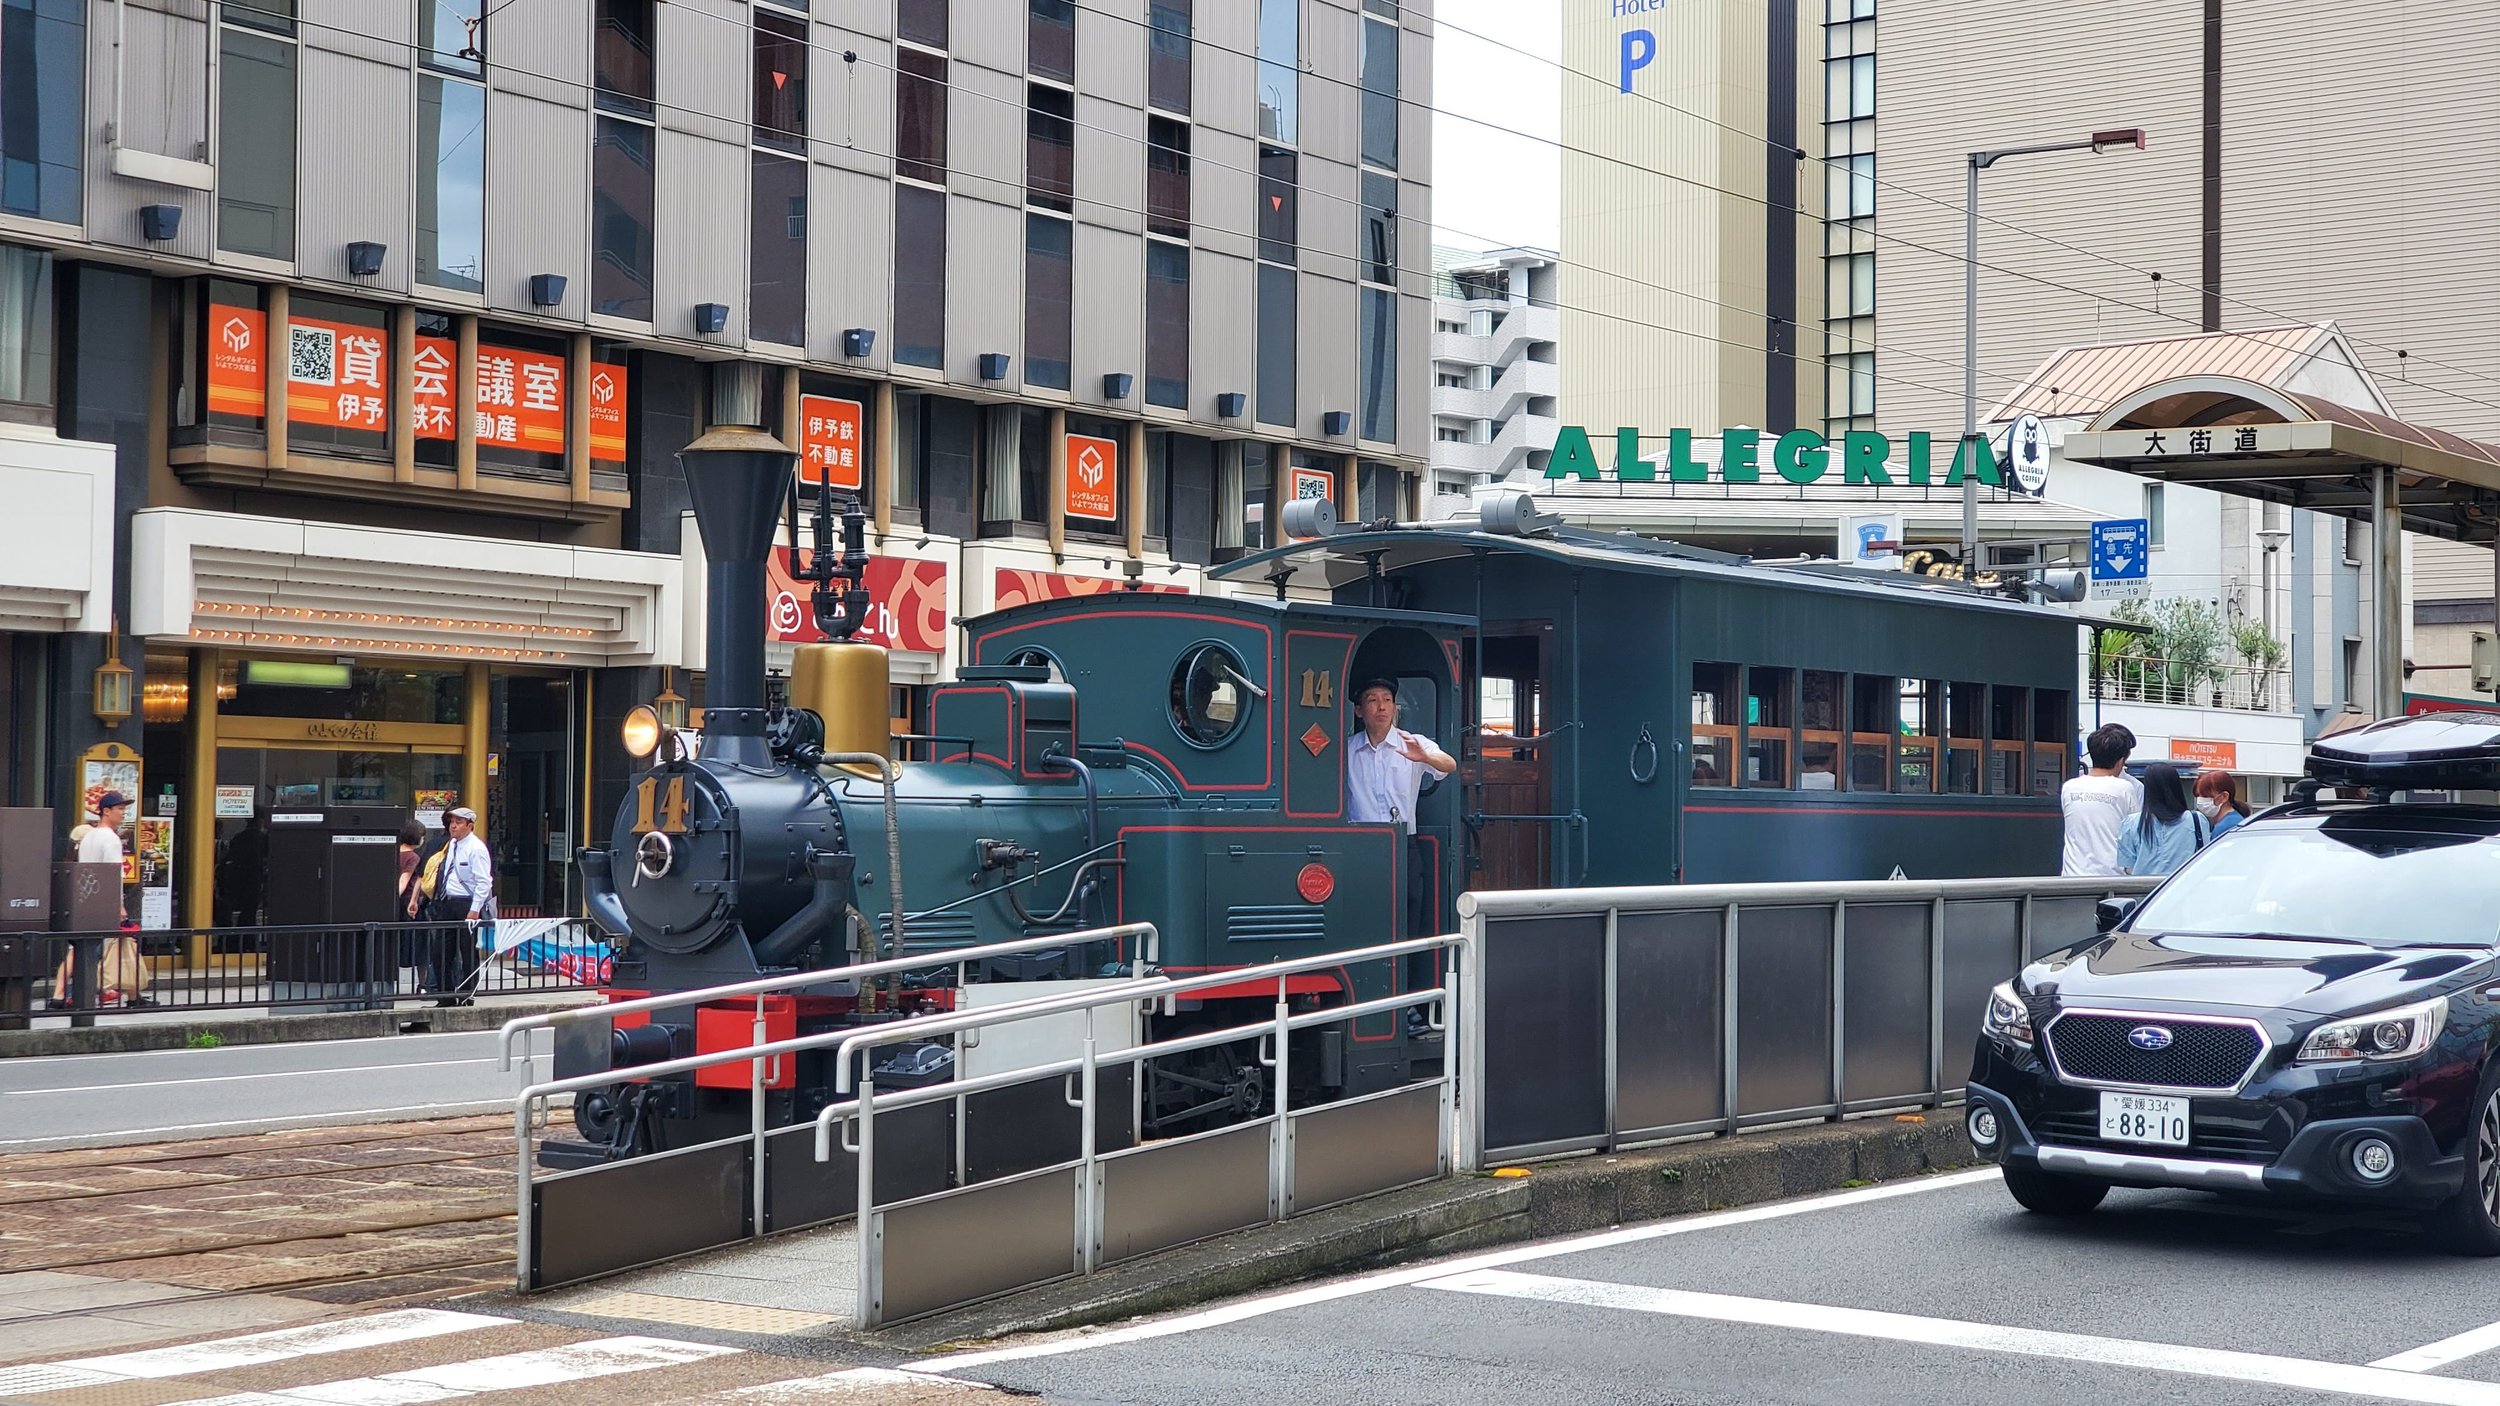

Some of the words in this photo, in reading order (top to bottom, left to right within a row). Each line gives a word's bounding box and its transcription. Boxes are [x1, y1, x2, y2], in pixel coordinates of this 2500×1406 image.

[1621, 29, 1656, 94] P
[808, 416, 854, 441] 伊予鉄
[2144, 427, 2258, 455] 大街道
[808, 443, 854, 468] 不動産
[1544, 426, 2001, 485] ALLEGRIA
[2018, 464, 2043, 475] ALLEGRIA
[2021, 474, 2040, 484] COFFEE
[1071, 490, 1109, 503] レンタルオフィス
[2106, 542, 2133, 555] 優先
[1300, 668, 1333, 708] 14
[630, 776, 690, 834] 14
[2106, 1118, 2115, 1129] と
[2119, 1112, 2184, 1141] 88-10
